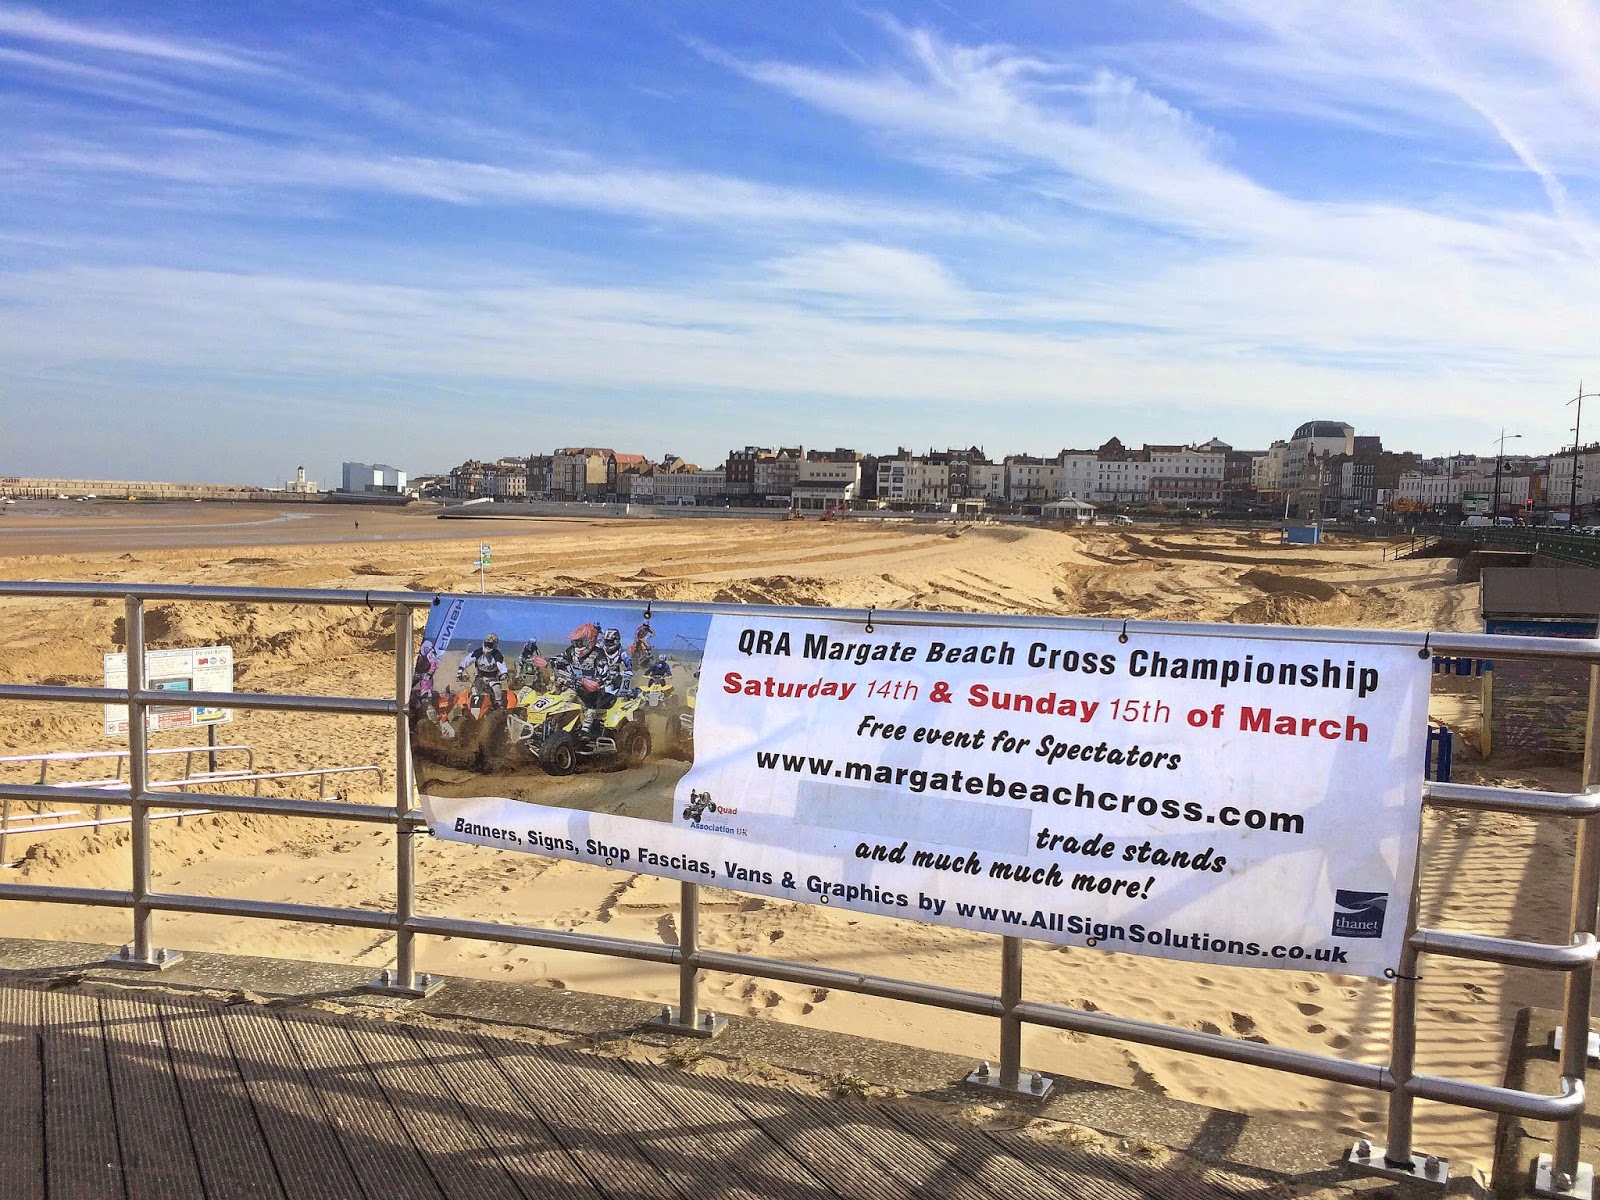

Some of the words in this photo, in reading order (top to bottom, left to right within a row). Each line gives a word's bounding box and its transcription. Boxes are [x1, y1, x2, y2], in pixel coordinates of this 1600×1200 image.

[738, 629, 791, 656] QRA
[803, 634, 917, 665] Margate
[926, 641, 1015, 665] Beach
[1028, 642, 1117, 675] Cross
[1129, 649, 1379, 697] Championship
[723, 672, 856, 701] Saturday
[866, 679, 919, 700] 14th
[929, 681, 952, 704] &
[967, 684, 1099, 723] Sunday
[1110, 698, 1170, 723] 15th
[1187, 704, 1225, 729] of
[1240, 706, 1369, 742] March
[857, 715, 905, 741] Free
[913, 724, 985, 751] event
[991, 730, 1030, 754] for
[1036, 735, 1182, 770] Spectators
[717, 806, 738, 814] Quad
[757, 752, 1305, 834] www.margatebeachcross.com
[690, 822, 734, 834] Association
[736, 828, 748, 836] UK
[1036, 827, 1114, 858] trade
[1122, 840, 1227, 873] stands
[454, 817, 522, 845] Banners,
[528, 831, 579, 855] Signs,
[586, 839, 630, 862] Shop
[638, 847, 716, 878] Fascias,
[725, 861, 773, 885] Vans
[782, 872, 797, 889] &
[806, 875, 909, 907] Graphics
[919, 893, 946, 916] by
[956, 903, 1348, 963] www.AllSignSolutions.co.uk
[855, 842, 909, 864] and
[912, 852, 982, 876] much
[989, 862, 1064, 887] much
[1072, 872, 1155, 899] more!
[1336, 917, 1378, 929] thanet
